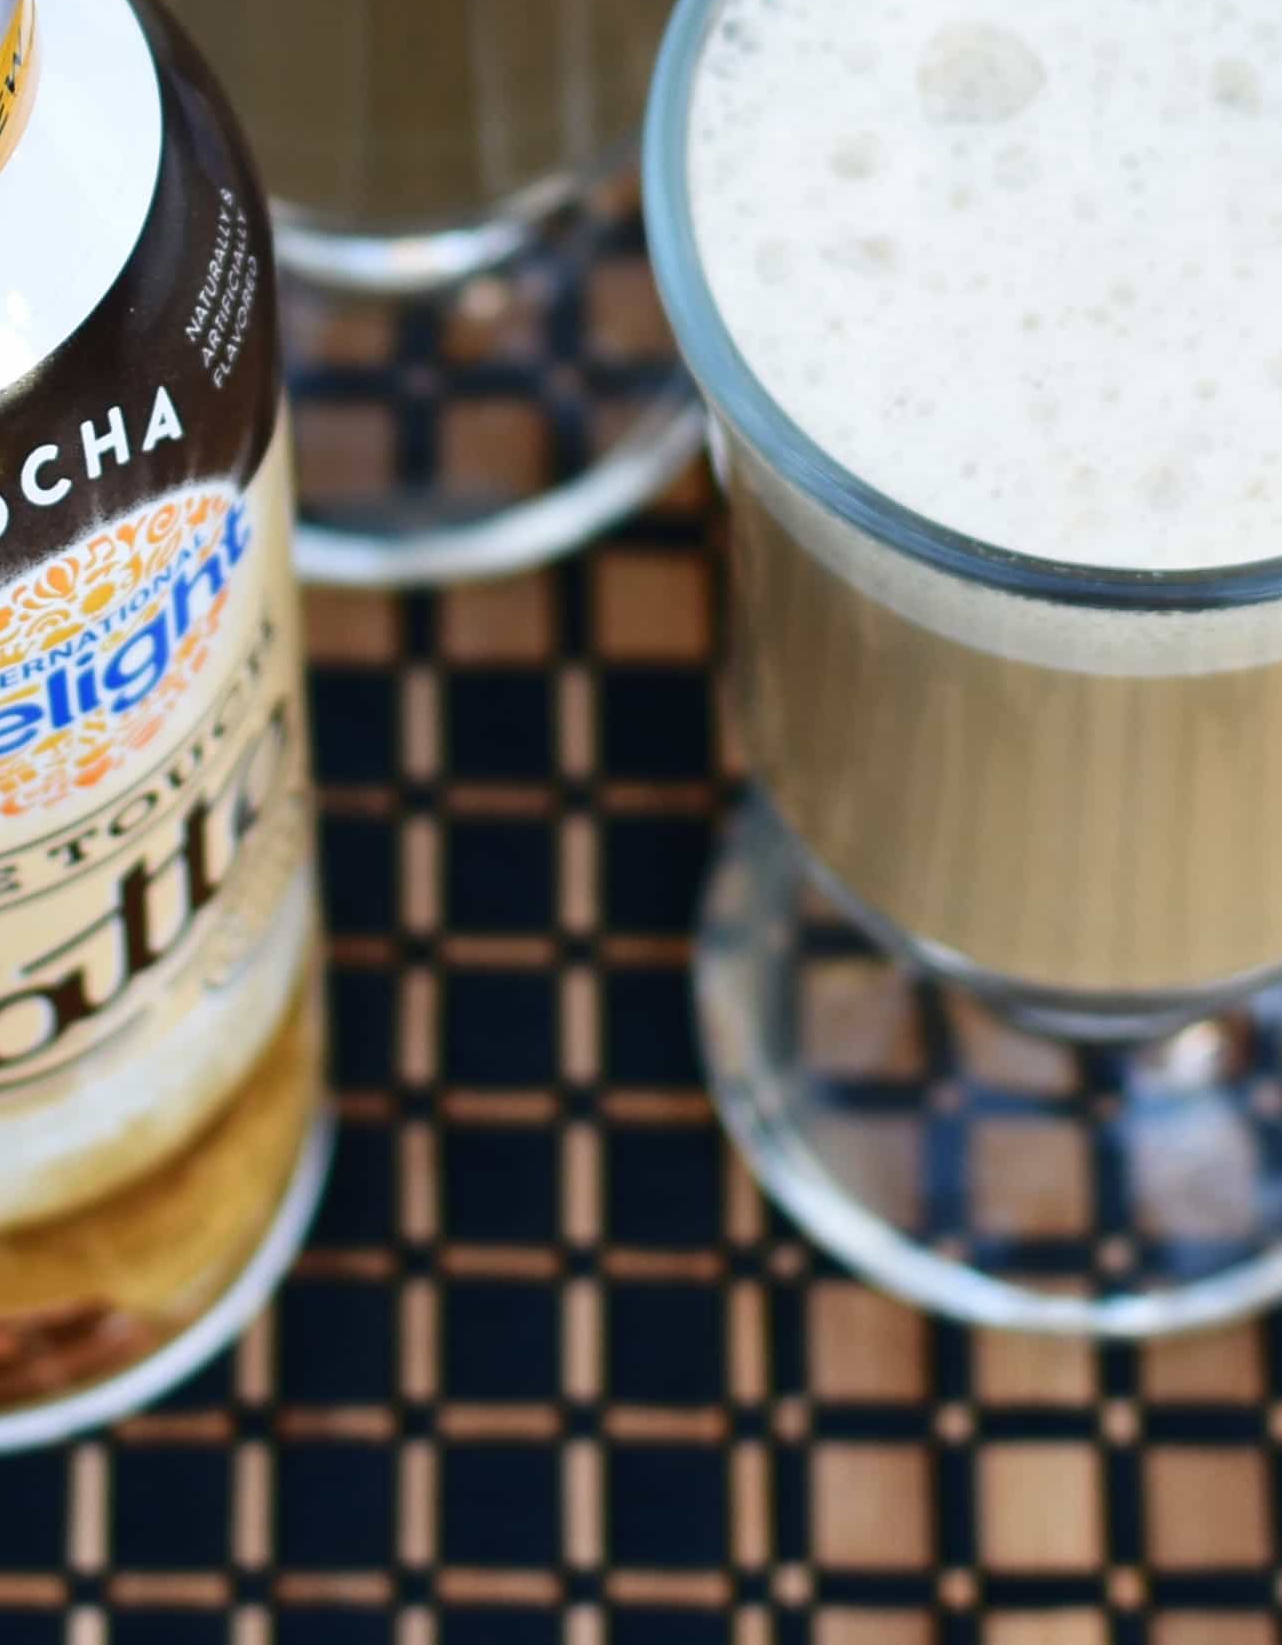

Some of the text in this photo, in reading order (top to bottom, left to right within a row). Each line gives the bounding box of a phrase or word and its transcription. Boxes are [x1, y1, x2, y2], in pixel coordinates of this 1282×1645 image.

[185, 207, 232, 342] NATURALLY
[202, 206, 247, 368] ARTIFICIALLY
[213, 255, 258, 389] FLAVORED
